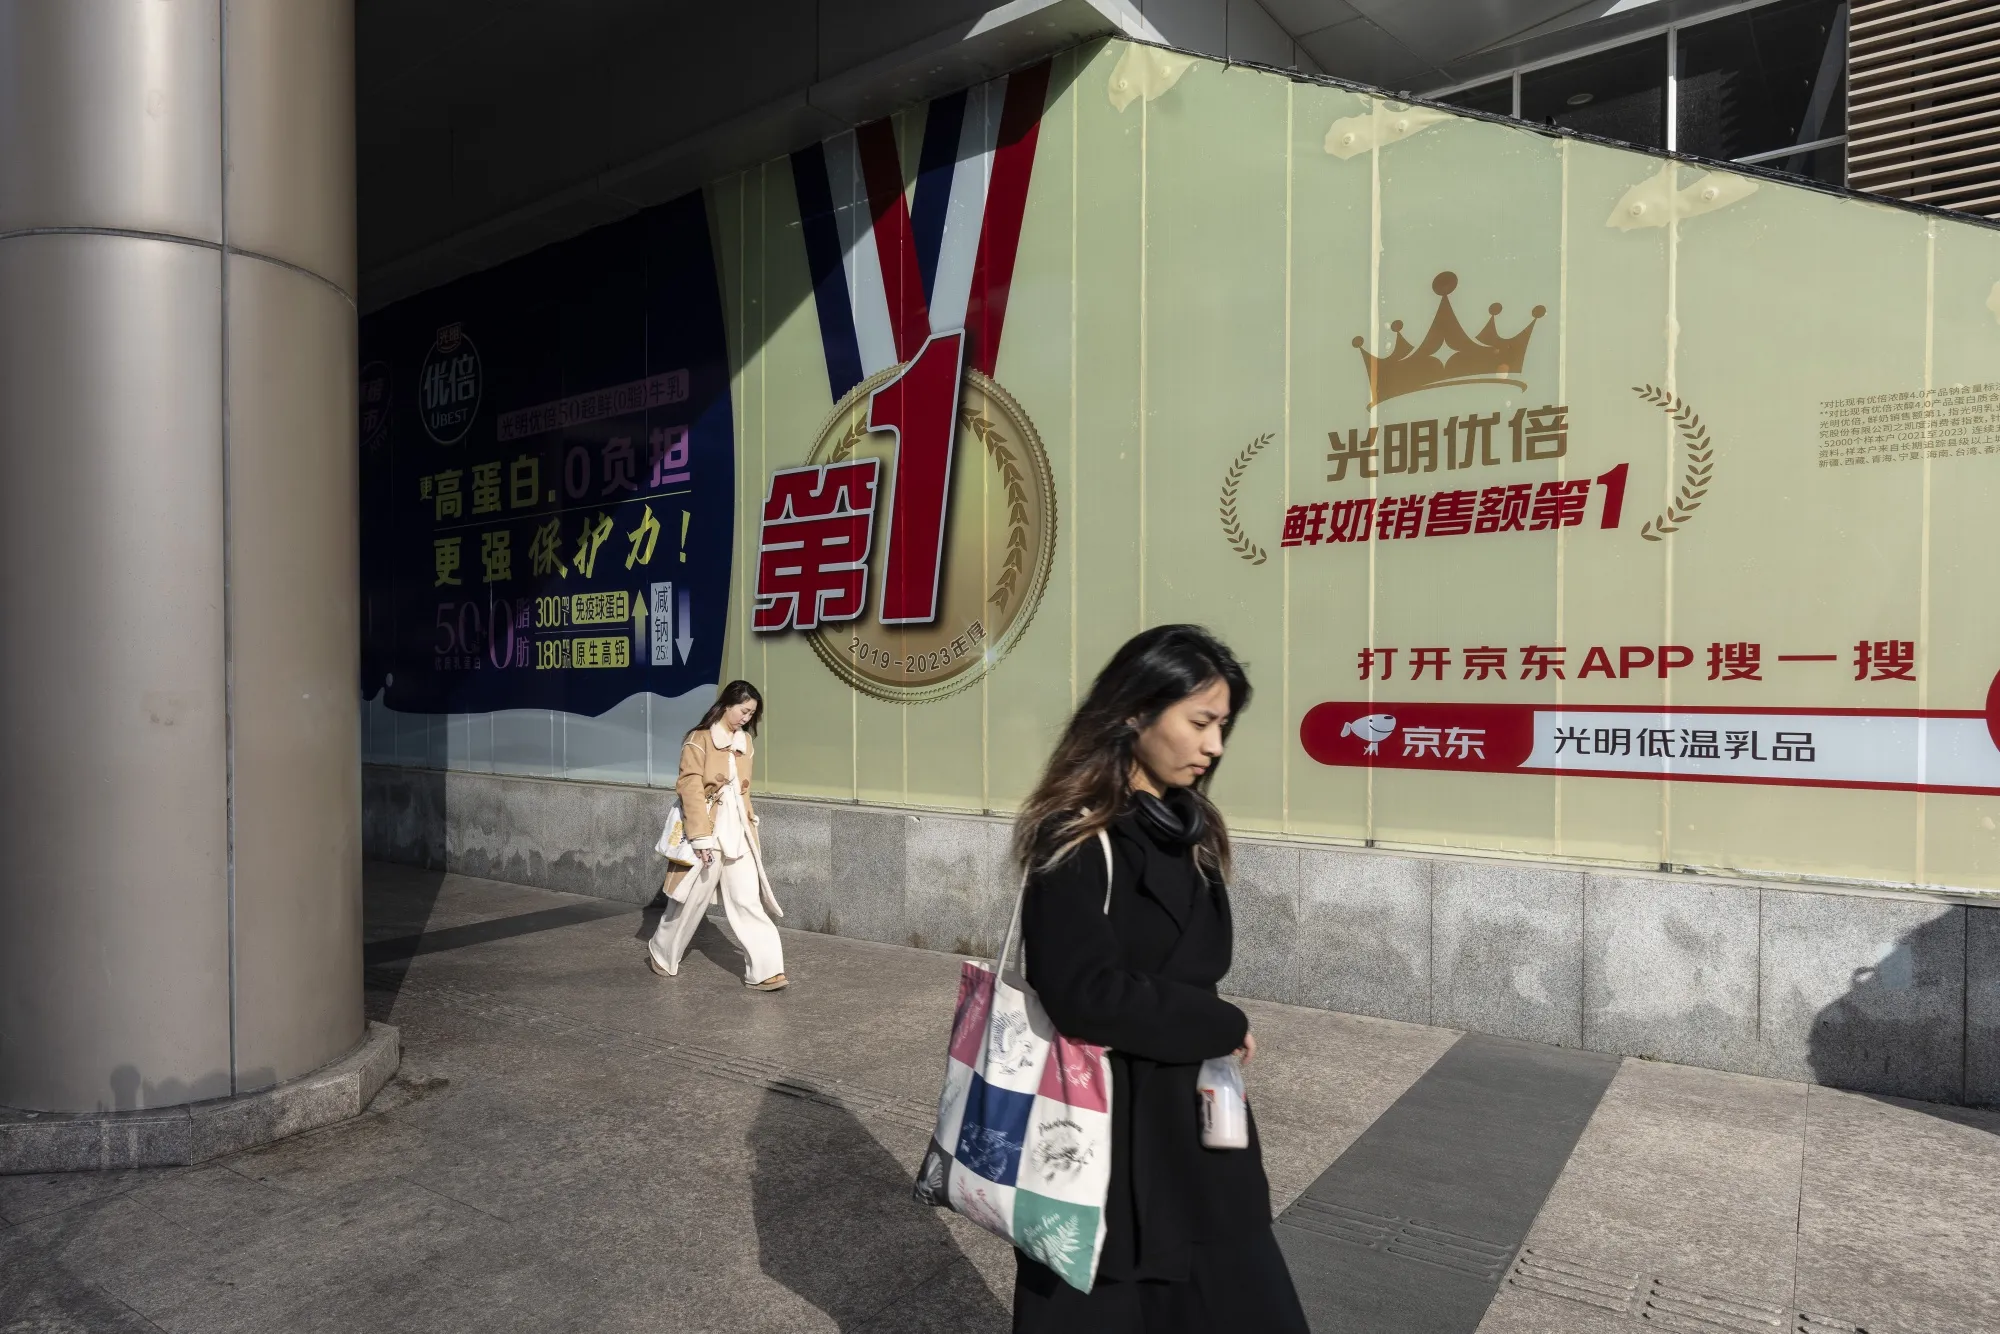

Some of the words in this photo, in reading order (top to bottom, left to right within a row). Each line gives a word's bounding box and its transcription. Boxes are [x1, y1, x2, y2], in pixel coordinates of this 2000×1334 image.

[424, 353, 476, 410] 优倍
[431, 407, 469, 429] UBEST
[1327, 405, 1568, 482] 光明优倍
[752, 328, 965, 631] 第1
[1280, 462, 1629, 547] 鲜奶销售额第1
[576, 594, 625, 621] 免疫球蛋白
[576, 639, 625, 665] 原生高钙
[847, 620, 987, 674] 2019-2023年度
[1357, 640, 1917, 682] 打开京东APP搜一搜
[1401, 725, 1486, 761] 京东
[1553, 727, 1816, 762] 光明低温乳品
